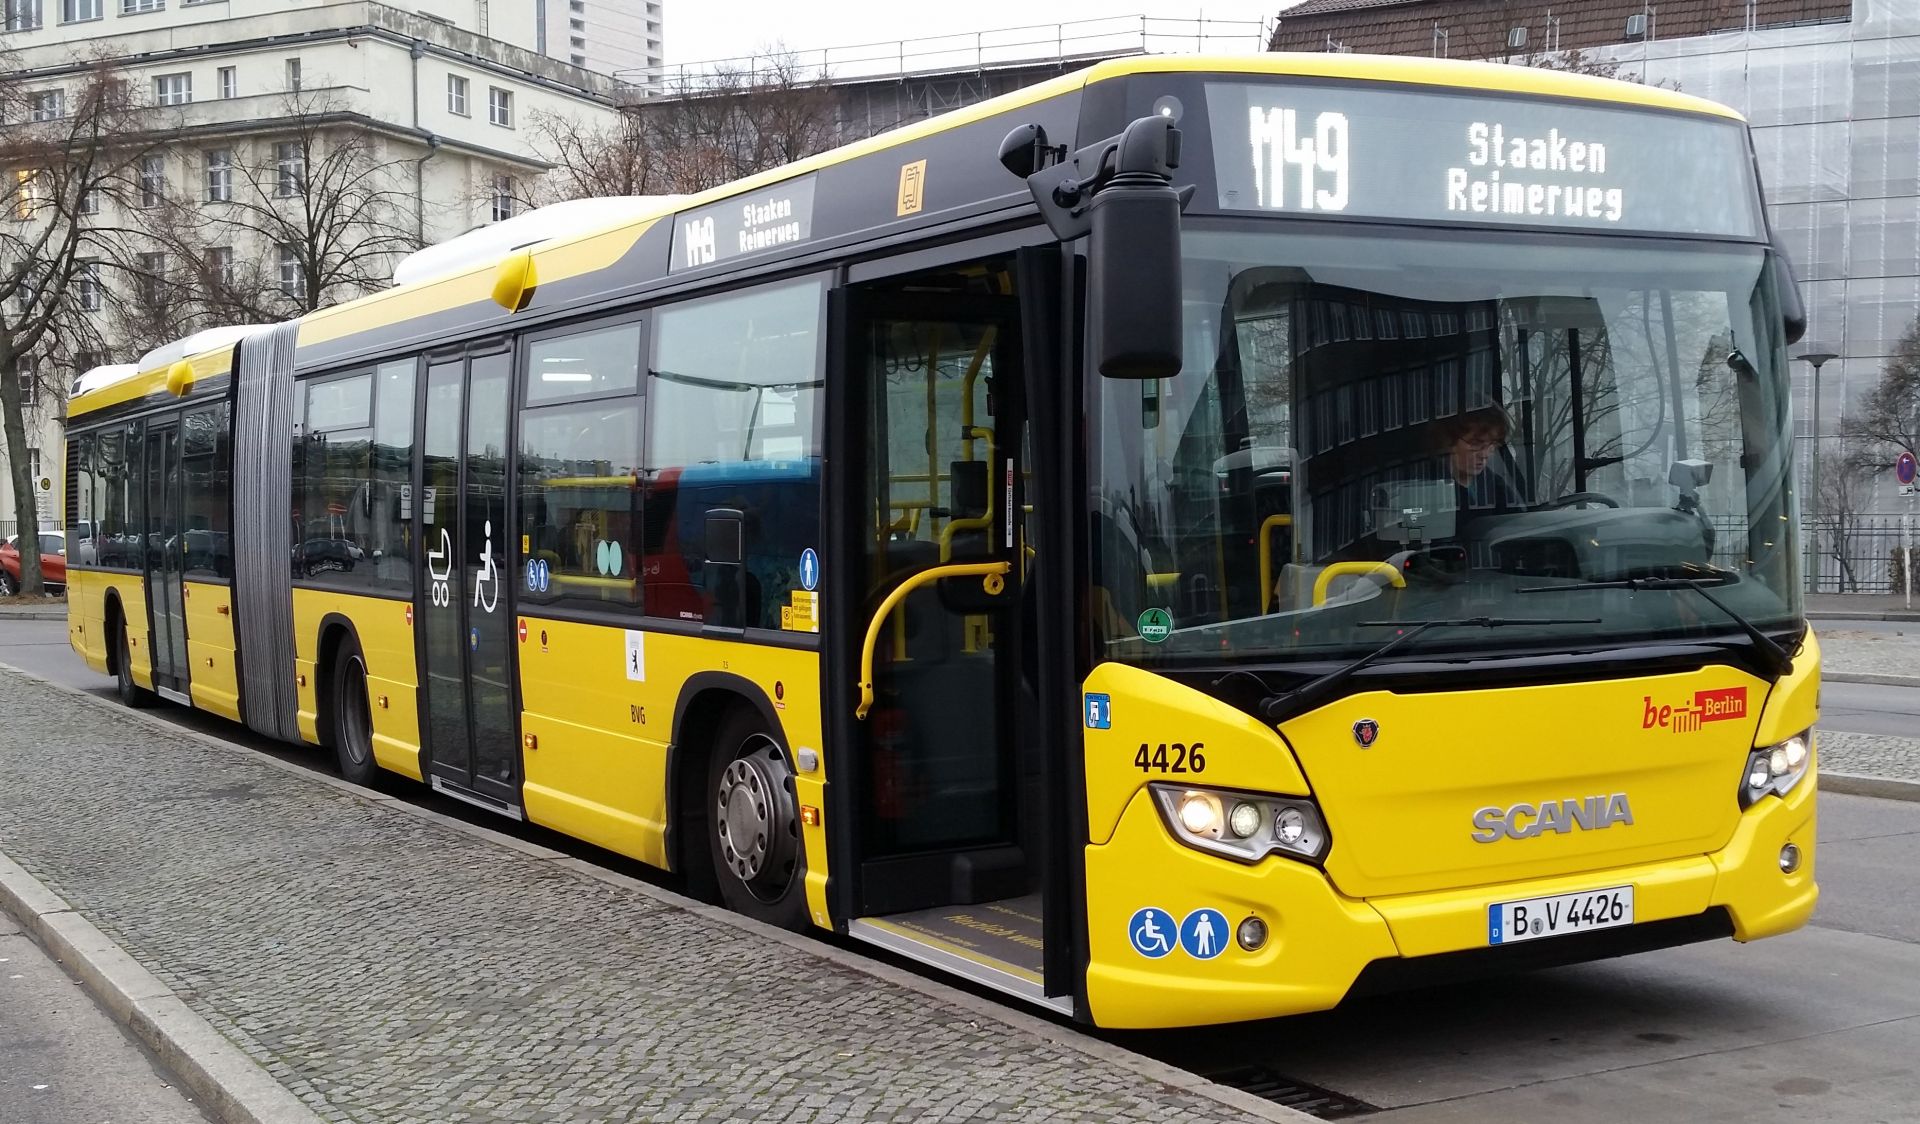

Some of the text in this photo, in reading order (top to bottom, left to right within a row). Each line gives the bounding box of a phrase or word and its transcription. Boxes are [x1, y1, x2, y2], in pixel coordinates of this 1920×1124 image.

[1249, 106, 1349, 211] M49
[1466, 121, 1606, 173] Staaken
[1447, 167, 1623, 222] Reimerweg
[743, 198, 791, 227] Staaken
[739, 221, 800, 252] Reimerweg
[1150, 611, 1160, 626] 4
[631, 704, 646, 725] BVG
[1642, 695, 1743, 729] be Berlin
[1134, 743, 1205, 773] 4426
[1471, 792, 1634, 843] SCANIA
[1513, 893, 1623, 936] B V 4426
[1492, 928, 1499, 938] D
